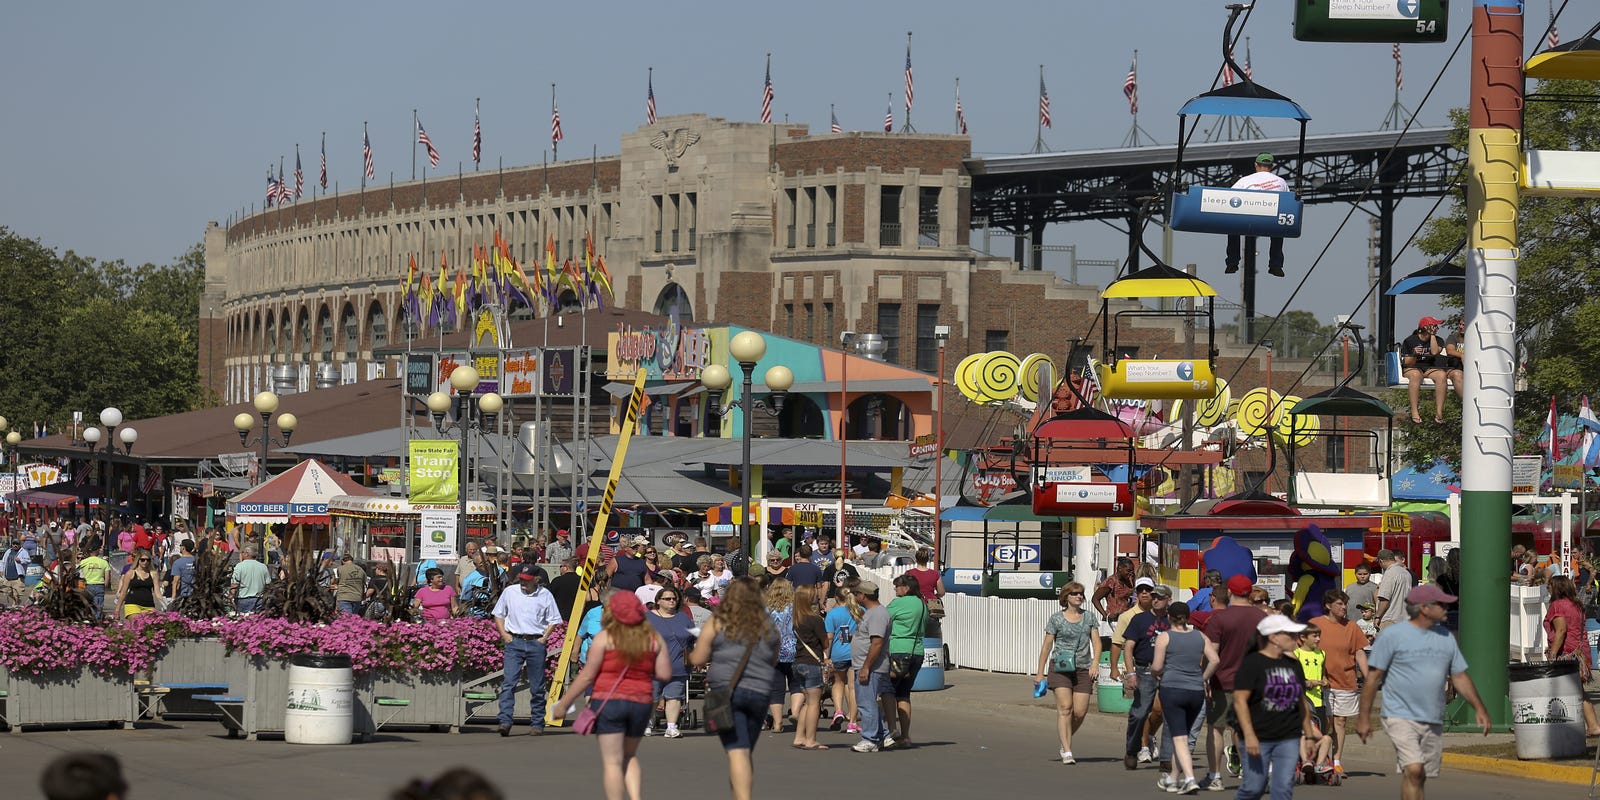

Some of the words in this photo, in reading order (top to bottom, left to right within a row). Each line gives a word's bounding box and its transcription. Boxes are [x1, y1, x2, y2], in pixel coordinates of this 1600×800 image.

[1331, 3, 1353, 12] Sleep
[1416, 20, 1436, 33] 54
[1203, 197, 1227, 205] sleep
[1278, 213, 1295, 225] 53
[1192, 380, 1208, 391] 52
[911, 443, 938, 455] CANTIN
[414, 455, 453, 466] Tram
[416, 468, 451, 480] Stop
[1058, 490, 1077, 498] sleep
[241, 504, 261, 512] ROOT
[263, 504, 284, 512] BEER
[296, 505, 314, 513] ICE
[794, 503, 818, 511] EXIT
[1112, 503, 1125, 512] 51
